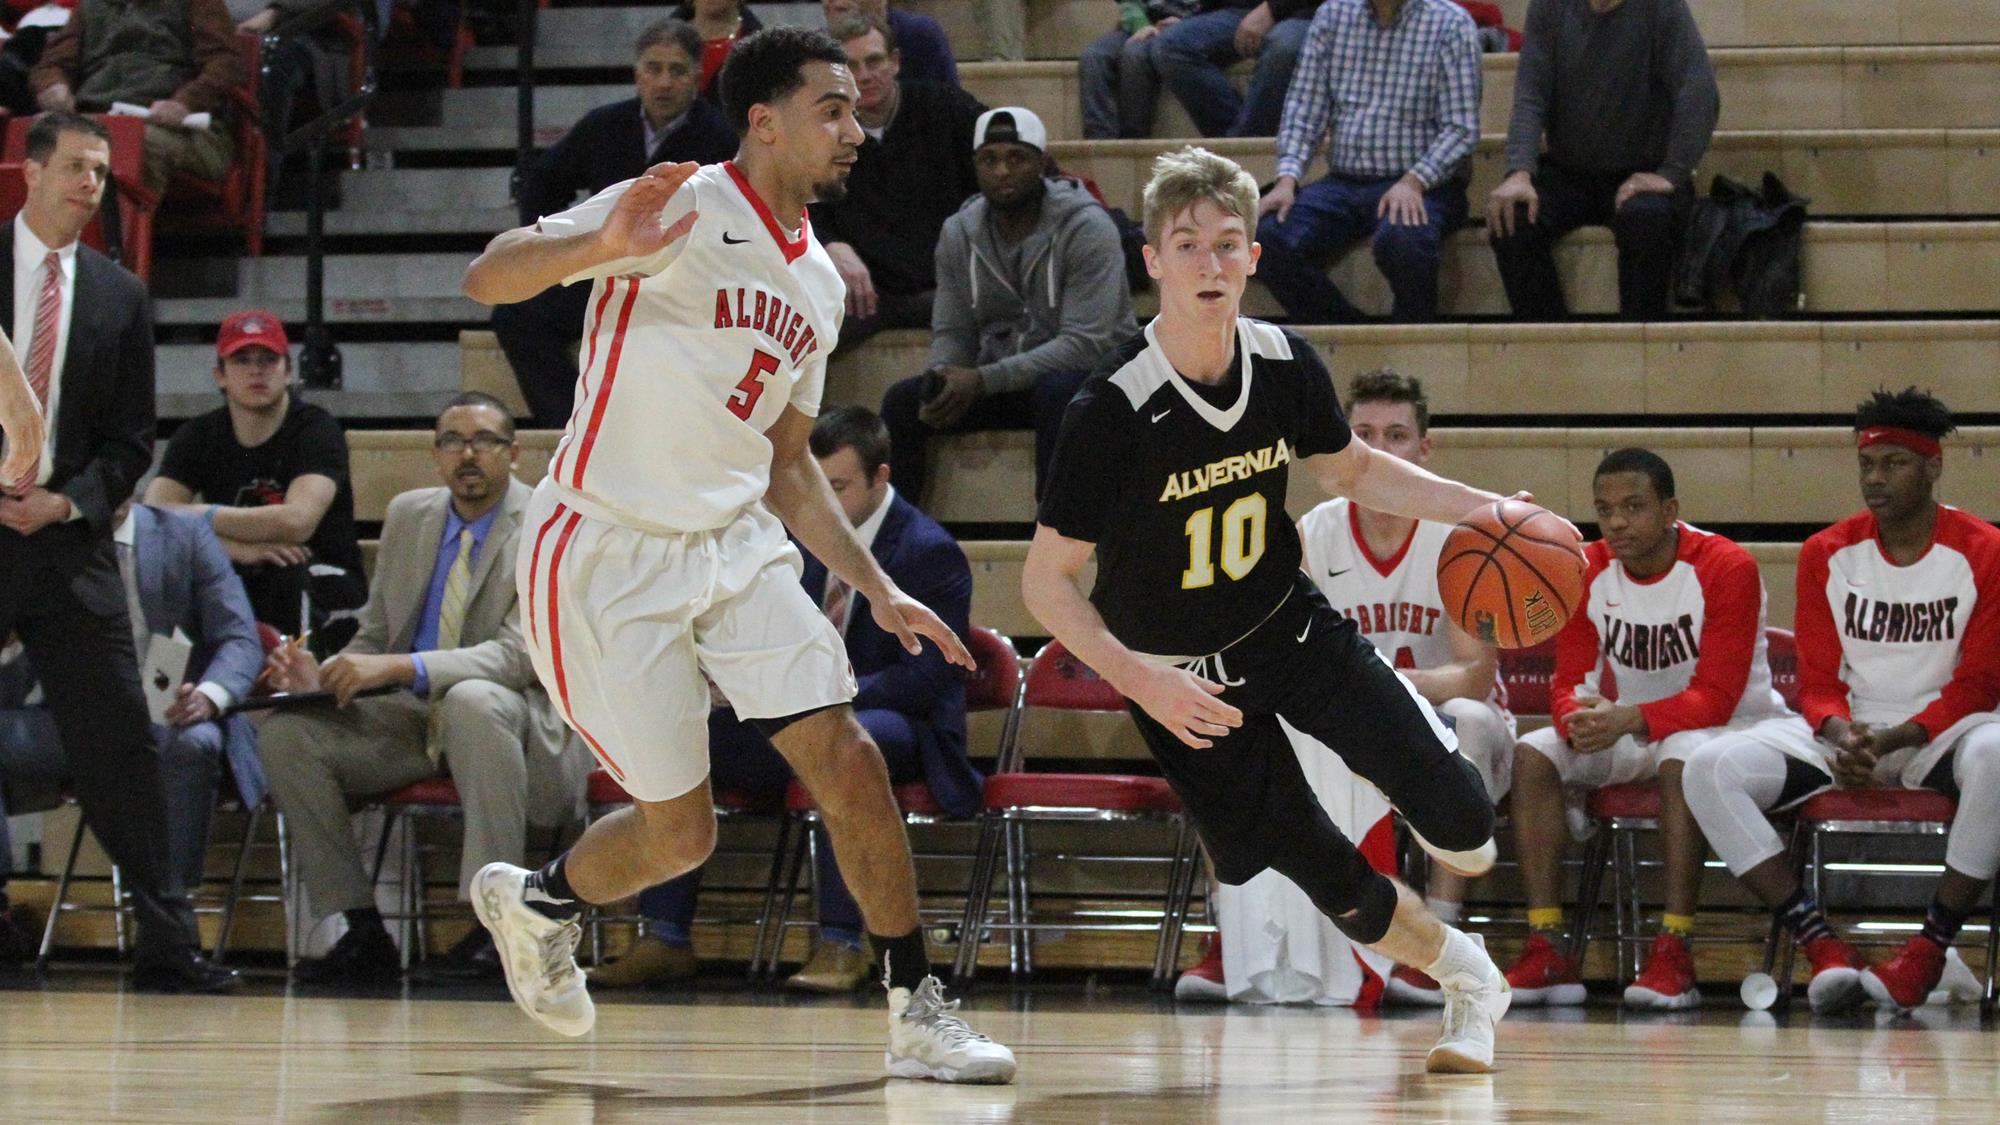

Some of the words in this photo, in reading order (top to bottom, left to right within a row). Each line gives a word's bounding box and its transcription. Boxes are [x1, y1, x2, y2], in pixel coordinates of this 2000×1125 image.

[725, 349, 781, 422] 5
[1159, 437, 1291, 503] ALVERNIA
[1181, 491, 1267, 590] 10
[1344, 602, 1441, 637] BRIGHT
[1524, 590, 1559, 636] ROCK
[1844, 591, 1958, 643] ALBRIGHT
